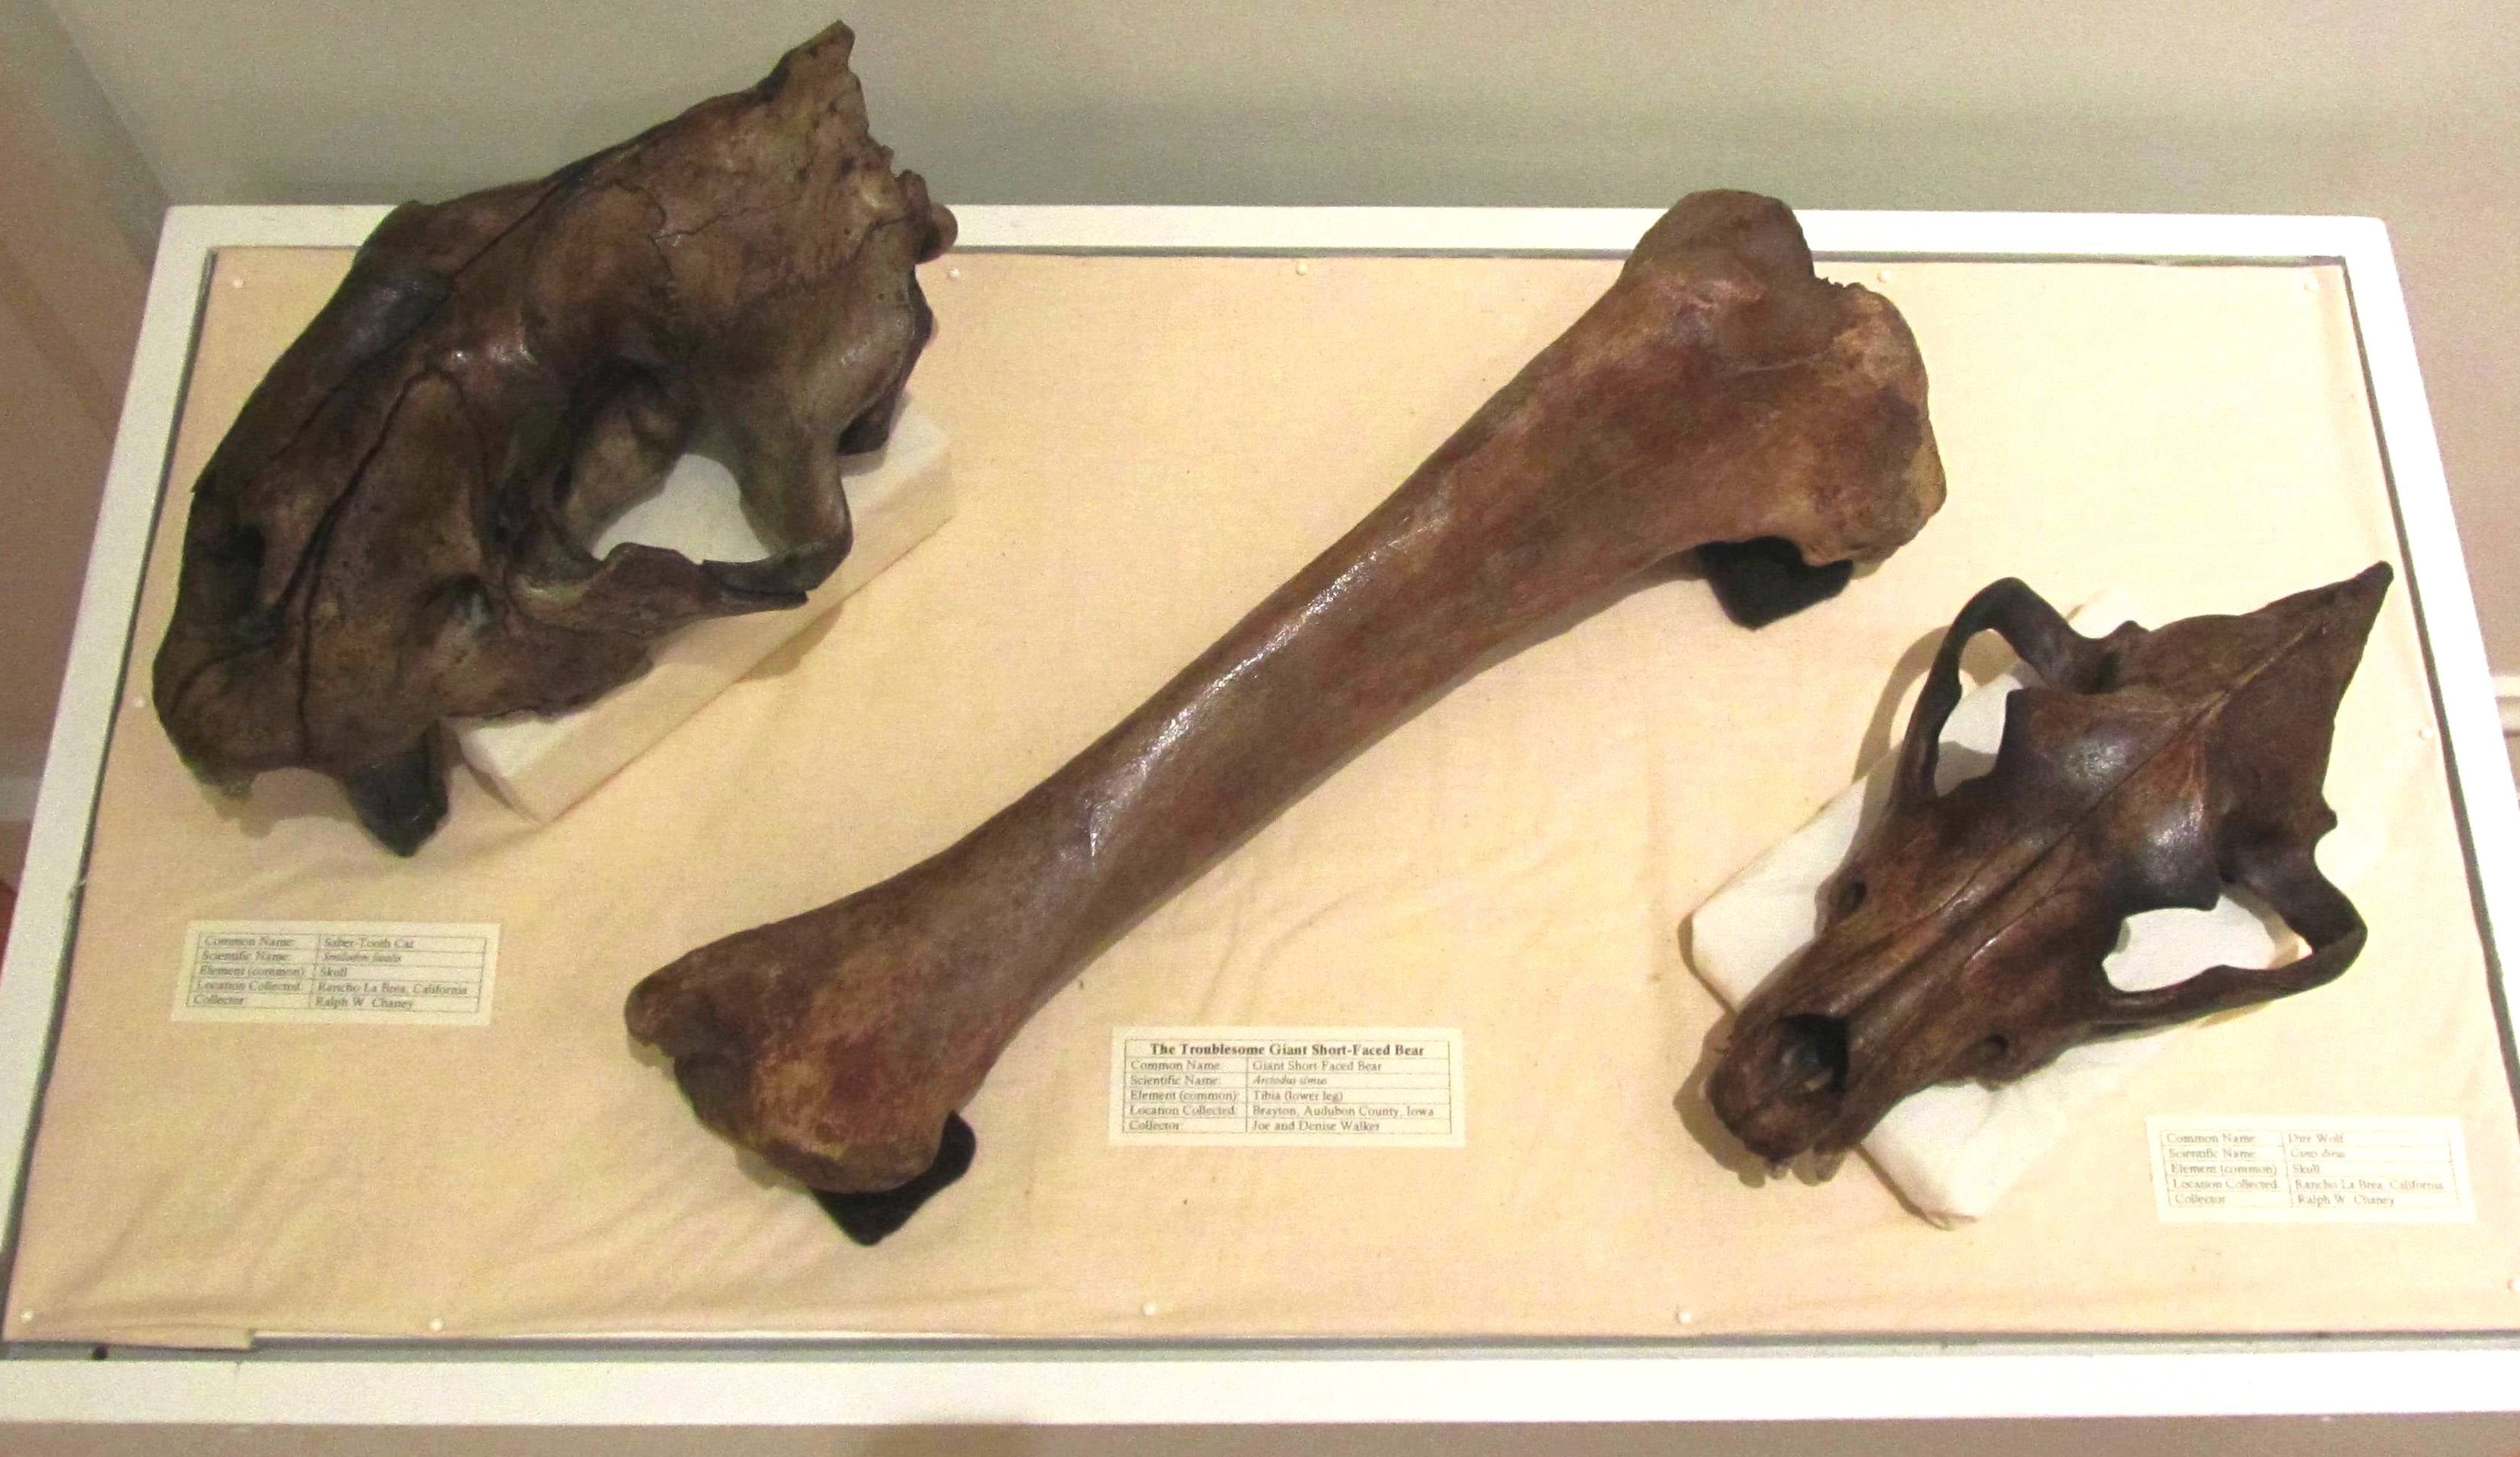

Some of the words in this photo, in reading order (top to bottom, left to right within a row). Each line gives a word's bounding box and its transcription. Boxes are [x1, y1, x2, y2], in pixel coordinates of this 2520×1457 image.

[204, 936, 255, 947] Common
[395, 938, 414, 949] Cat
[200, 965, 244, 976] Element
[321, 967, 348, 977] Skull
[197, 980, 245, 990] Location
[318, 982, 360, 993] Rancho
[364, 983, 377, 993] La
[413, 983, 468, 995] California
[315, 996, 348, 1009] Ralph
[371, 998, 414, 1011] Chaney
[1150, 1043, 1175, 1055] The
[1181, 1043, 1265, 1056] Troublesome
[1270, 1043, 1307, 1056] Giant
[1312, 1043, 1390, 1056] Short-Faced
[1395, 1043, 1425, 1056] Bear
[1131, 1059, 1183, 1071] Common
[1252, 1060, 1284, 1071] Giant
[1358, 1060, 1382, 1071] Bear
[1131, 1074, 1181, 1085] Scientific
[1130, 1090, 1175, 1100] Element
[1253, 1090, 1280, 1101] Tibia
[1284, 1090, 1318, 1102] (lower
[1323, 1090, 1344, 1103] leg)
[1130, 1104, 1179, 1115] Location
[1304, 1106, 1355, 1117] Audubon
[1407, 1106, 1434, 1117] Iowa
[1252, 1121, 1270, 1132] Joe
[1274, 1121, 1295, 1132] and
[1299, 1121, 1336, 1132] Denise
[1341, 1121, 1379, 1132] Walker
[2167, 1133, 2219, 1144] Common
[2317, 1133, 2344, 1144] Wolf
[2171, 1163, 2217, 1174] Element
[2292, 1164, 2320, 1173] Skull
[2173, 1178, 2222, 1189] Location
[2295, 1179, 2338, 1190] Rancho
[2342, 1180, 2355, 1189] La
[2389, 1180, 2444, 1191] California
[2298, 1194, 2331, 1207] Ralph
